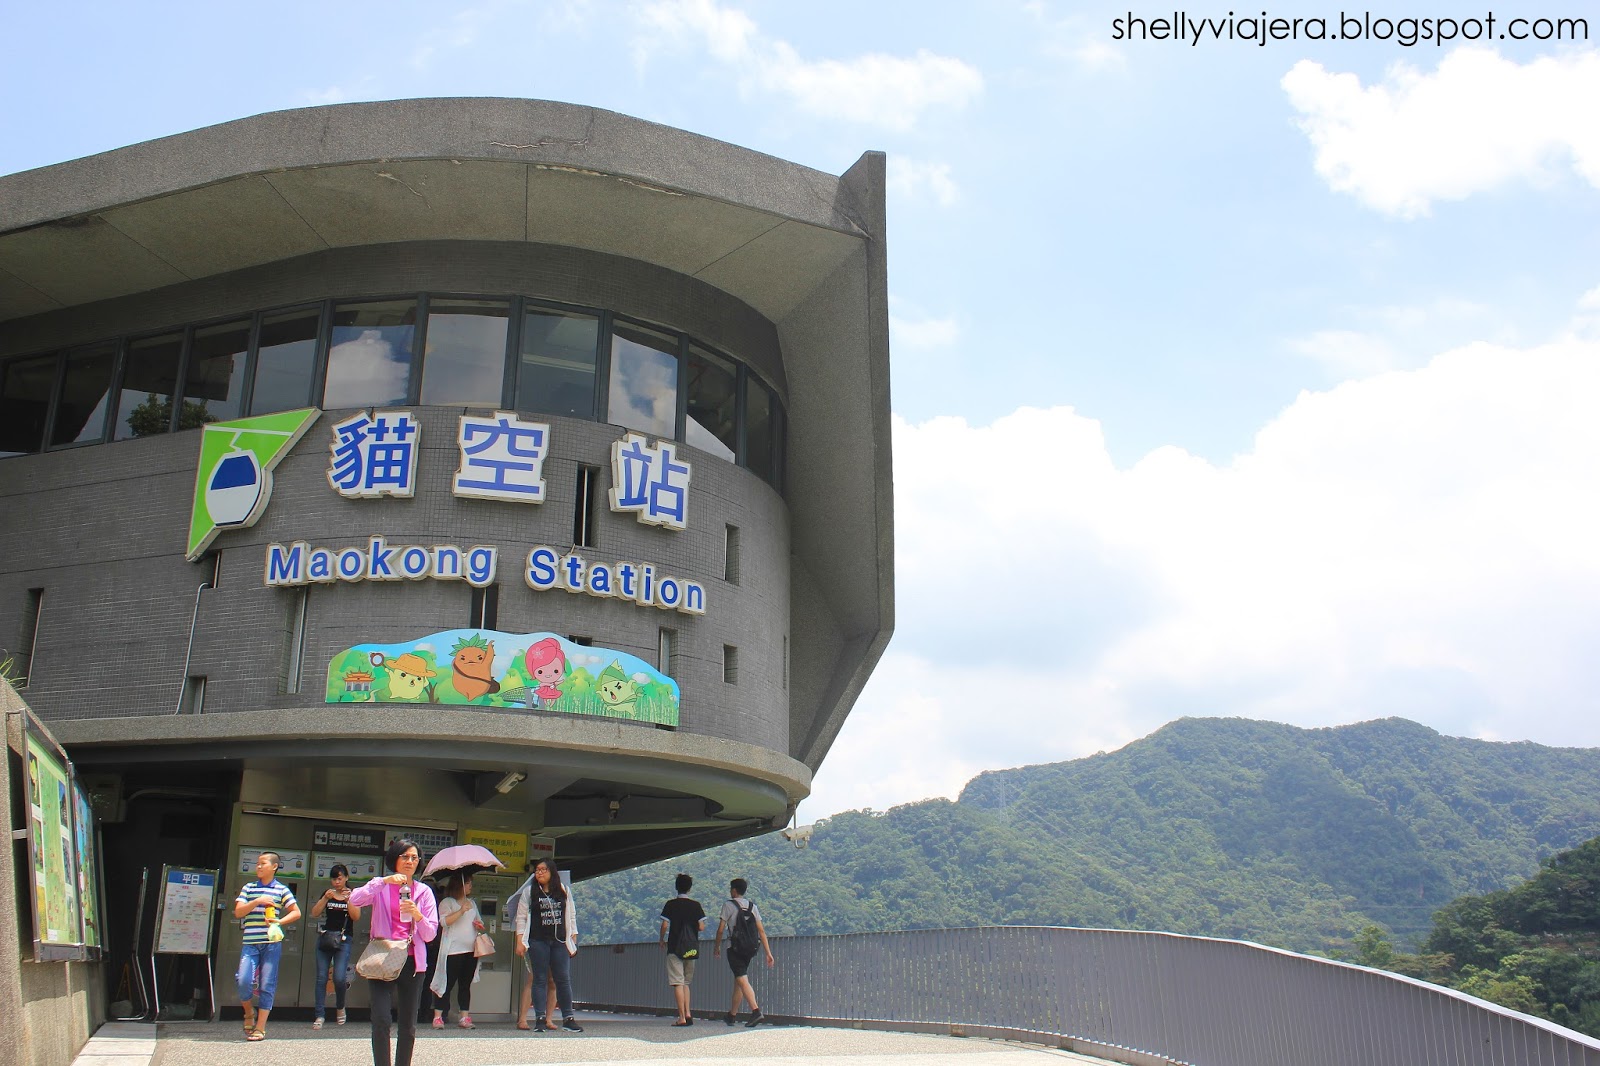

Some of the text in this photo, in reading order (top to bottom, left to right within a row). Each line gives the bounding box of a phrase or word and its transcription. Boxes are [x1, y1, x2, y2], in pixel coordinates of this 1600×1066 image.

[329, 416, 689, 523] 貓空站
[267, 536, 706, 611] Maokong Station
[182, 873, 200, 885] 平日
